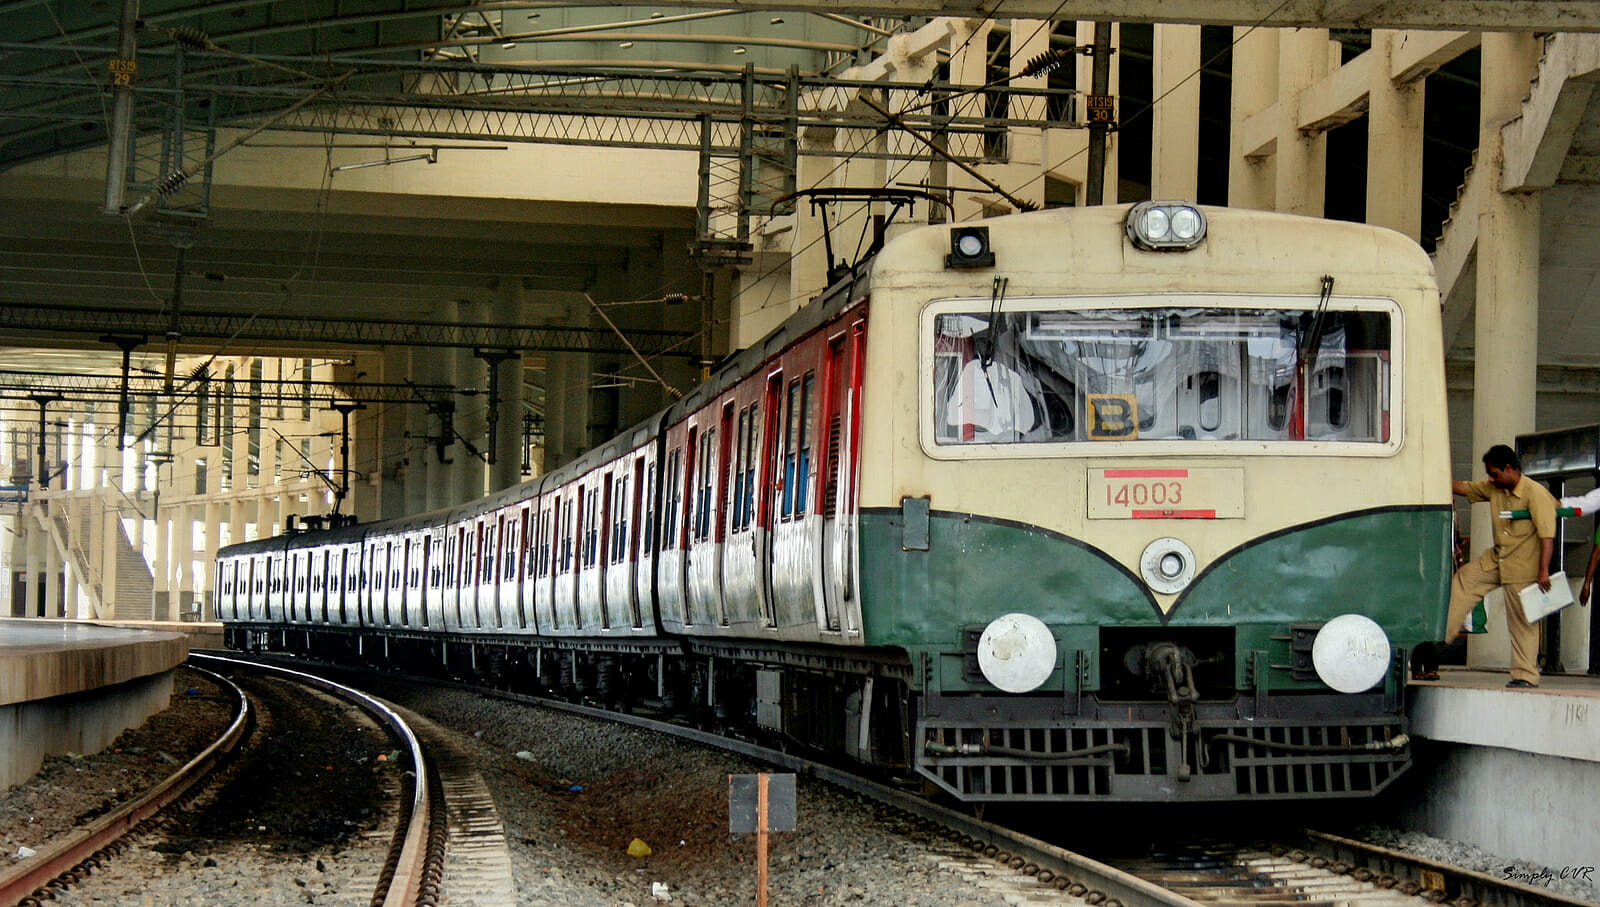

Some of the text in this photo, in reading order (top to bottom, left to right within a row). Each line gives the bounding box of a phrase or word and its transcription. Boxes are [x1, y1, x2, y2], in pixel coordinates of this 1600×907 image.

[114, 72, 130, 86] 29
[1087, 96, 1113, 108] RTS19
[1093, 110, 1108, 120] 30
[1091, 398, 1134, 436] B
[1106, 481, 1183, 507] 14003
